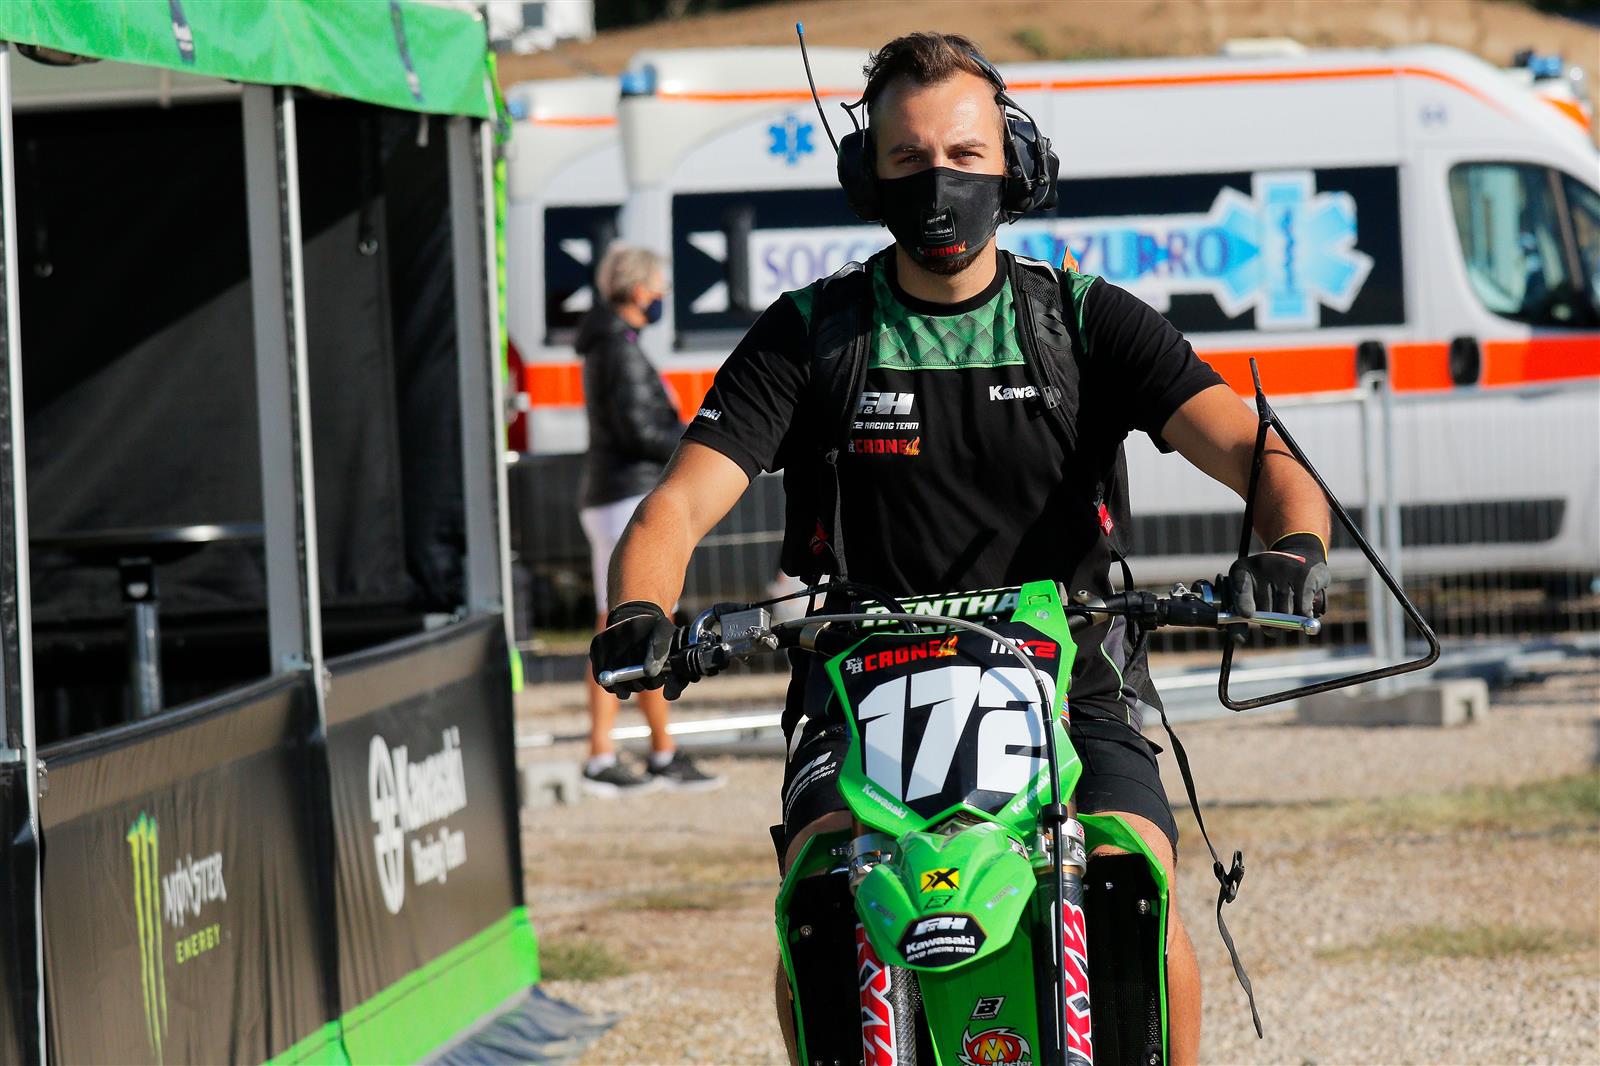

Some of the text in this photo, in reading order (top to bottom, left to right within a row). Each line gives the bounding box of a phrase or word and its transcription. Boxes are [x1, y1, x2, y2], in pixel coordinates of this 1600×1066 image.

[864, 421, 895, 430] RACING
[895, 421, 920, 430] TEAM
[855, 438, 909, 454] CRONE
[865, 639, 943, 672] CRONE
[857, 665, 1057, 803] 172
[861, 783, 909, 819] Kawasaki
[162, 852, 228, 928] MONSTER
[175, 923, 220, 964] ENERGY
[906, 935, 976, 955] Kawasaki
